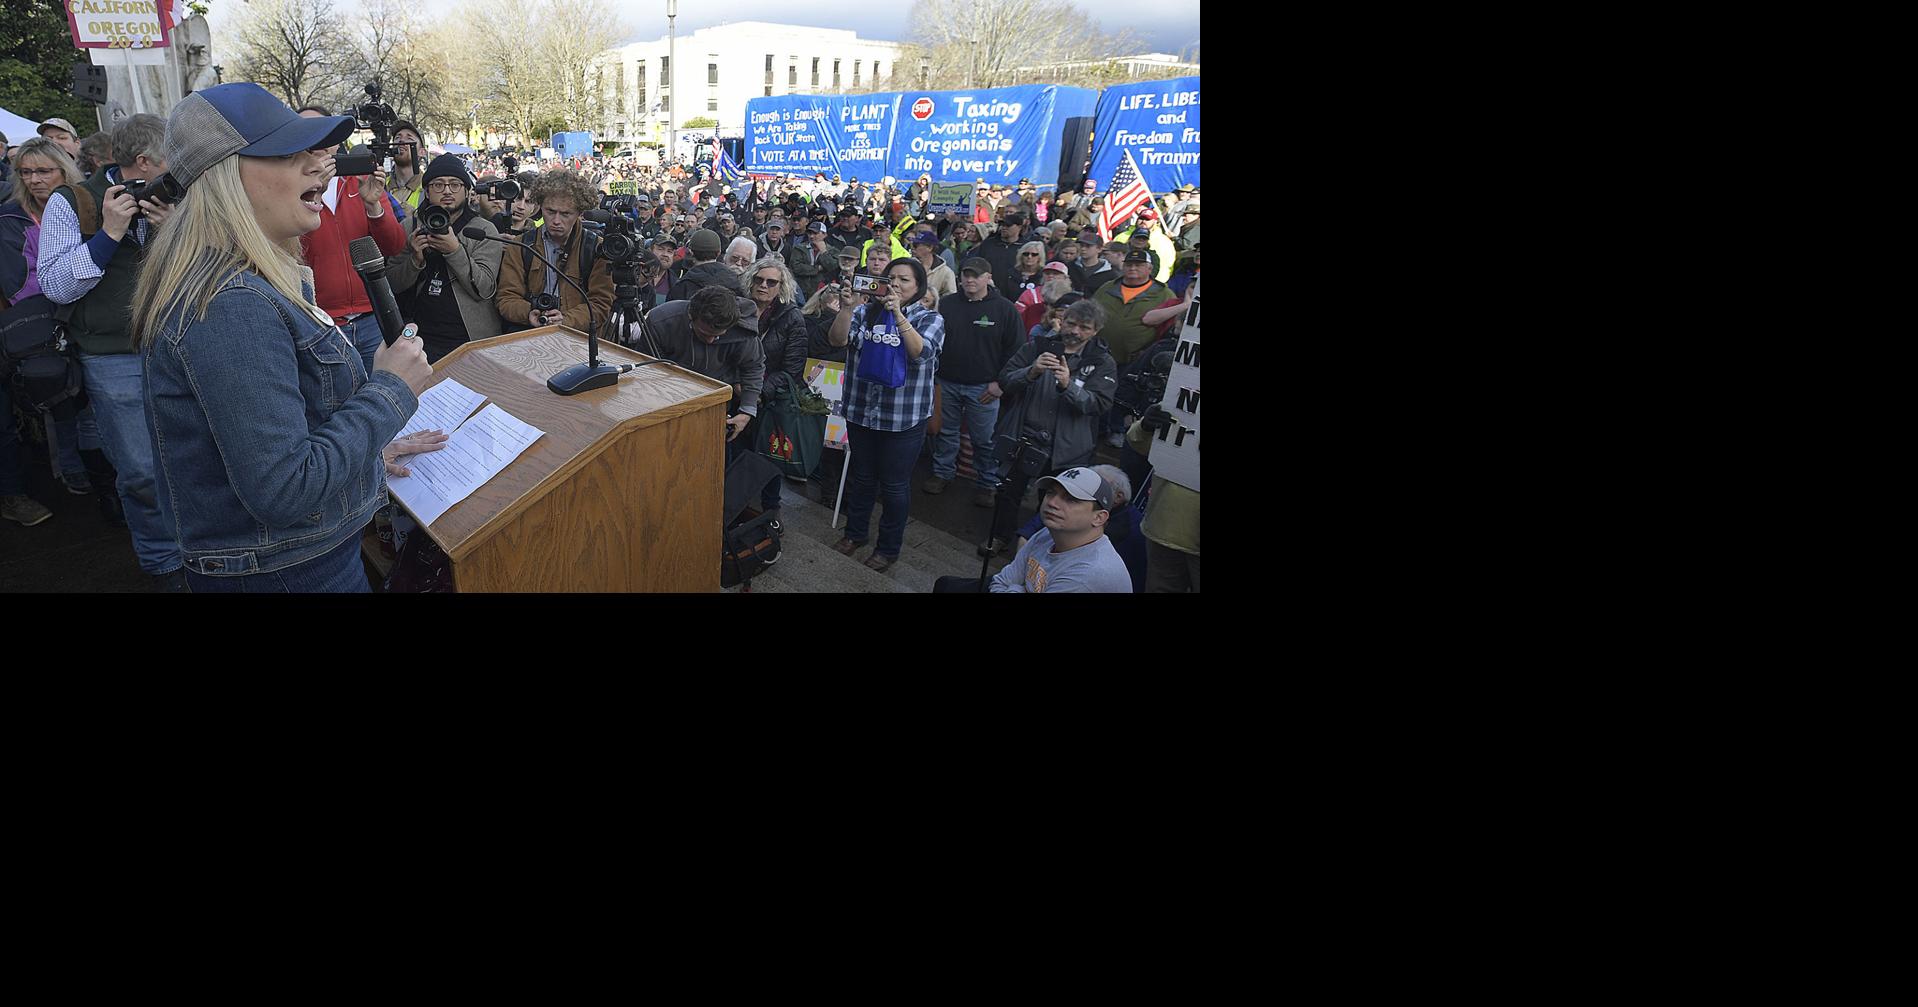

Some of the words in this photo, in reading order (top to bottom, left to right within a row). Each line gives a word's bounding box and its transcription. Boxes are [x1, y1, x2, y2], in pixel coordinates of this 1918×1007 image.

[88, 21, 160, 35] OREGON
[107, 35, 153, 48] 2020
[1161, 91, 1200, 107] LIBE
[751, 110, 780, 124] Enough
[782, 108, 791, 119] is
[841, 104, 889, 122] PLANT
[953, 96, 1021, 124] Taxing
[1157, 111, 1186, 124] and
[753, 125, 766, 135] We
[767, 122, 782, 133] Are
[784, 121, 807, 132] Taking
[930, 119, 998, 137] working
[754, 136, 771, 145] Back
[851, 139, 871, 149] LESS
[1115, 130, 1173, 145] Freedom
[760, 150, 785, 162] VOTE
[904, 154, 933, 171] into
[942, 155, 1019, 177] poverty
